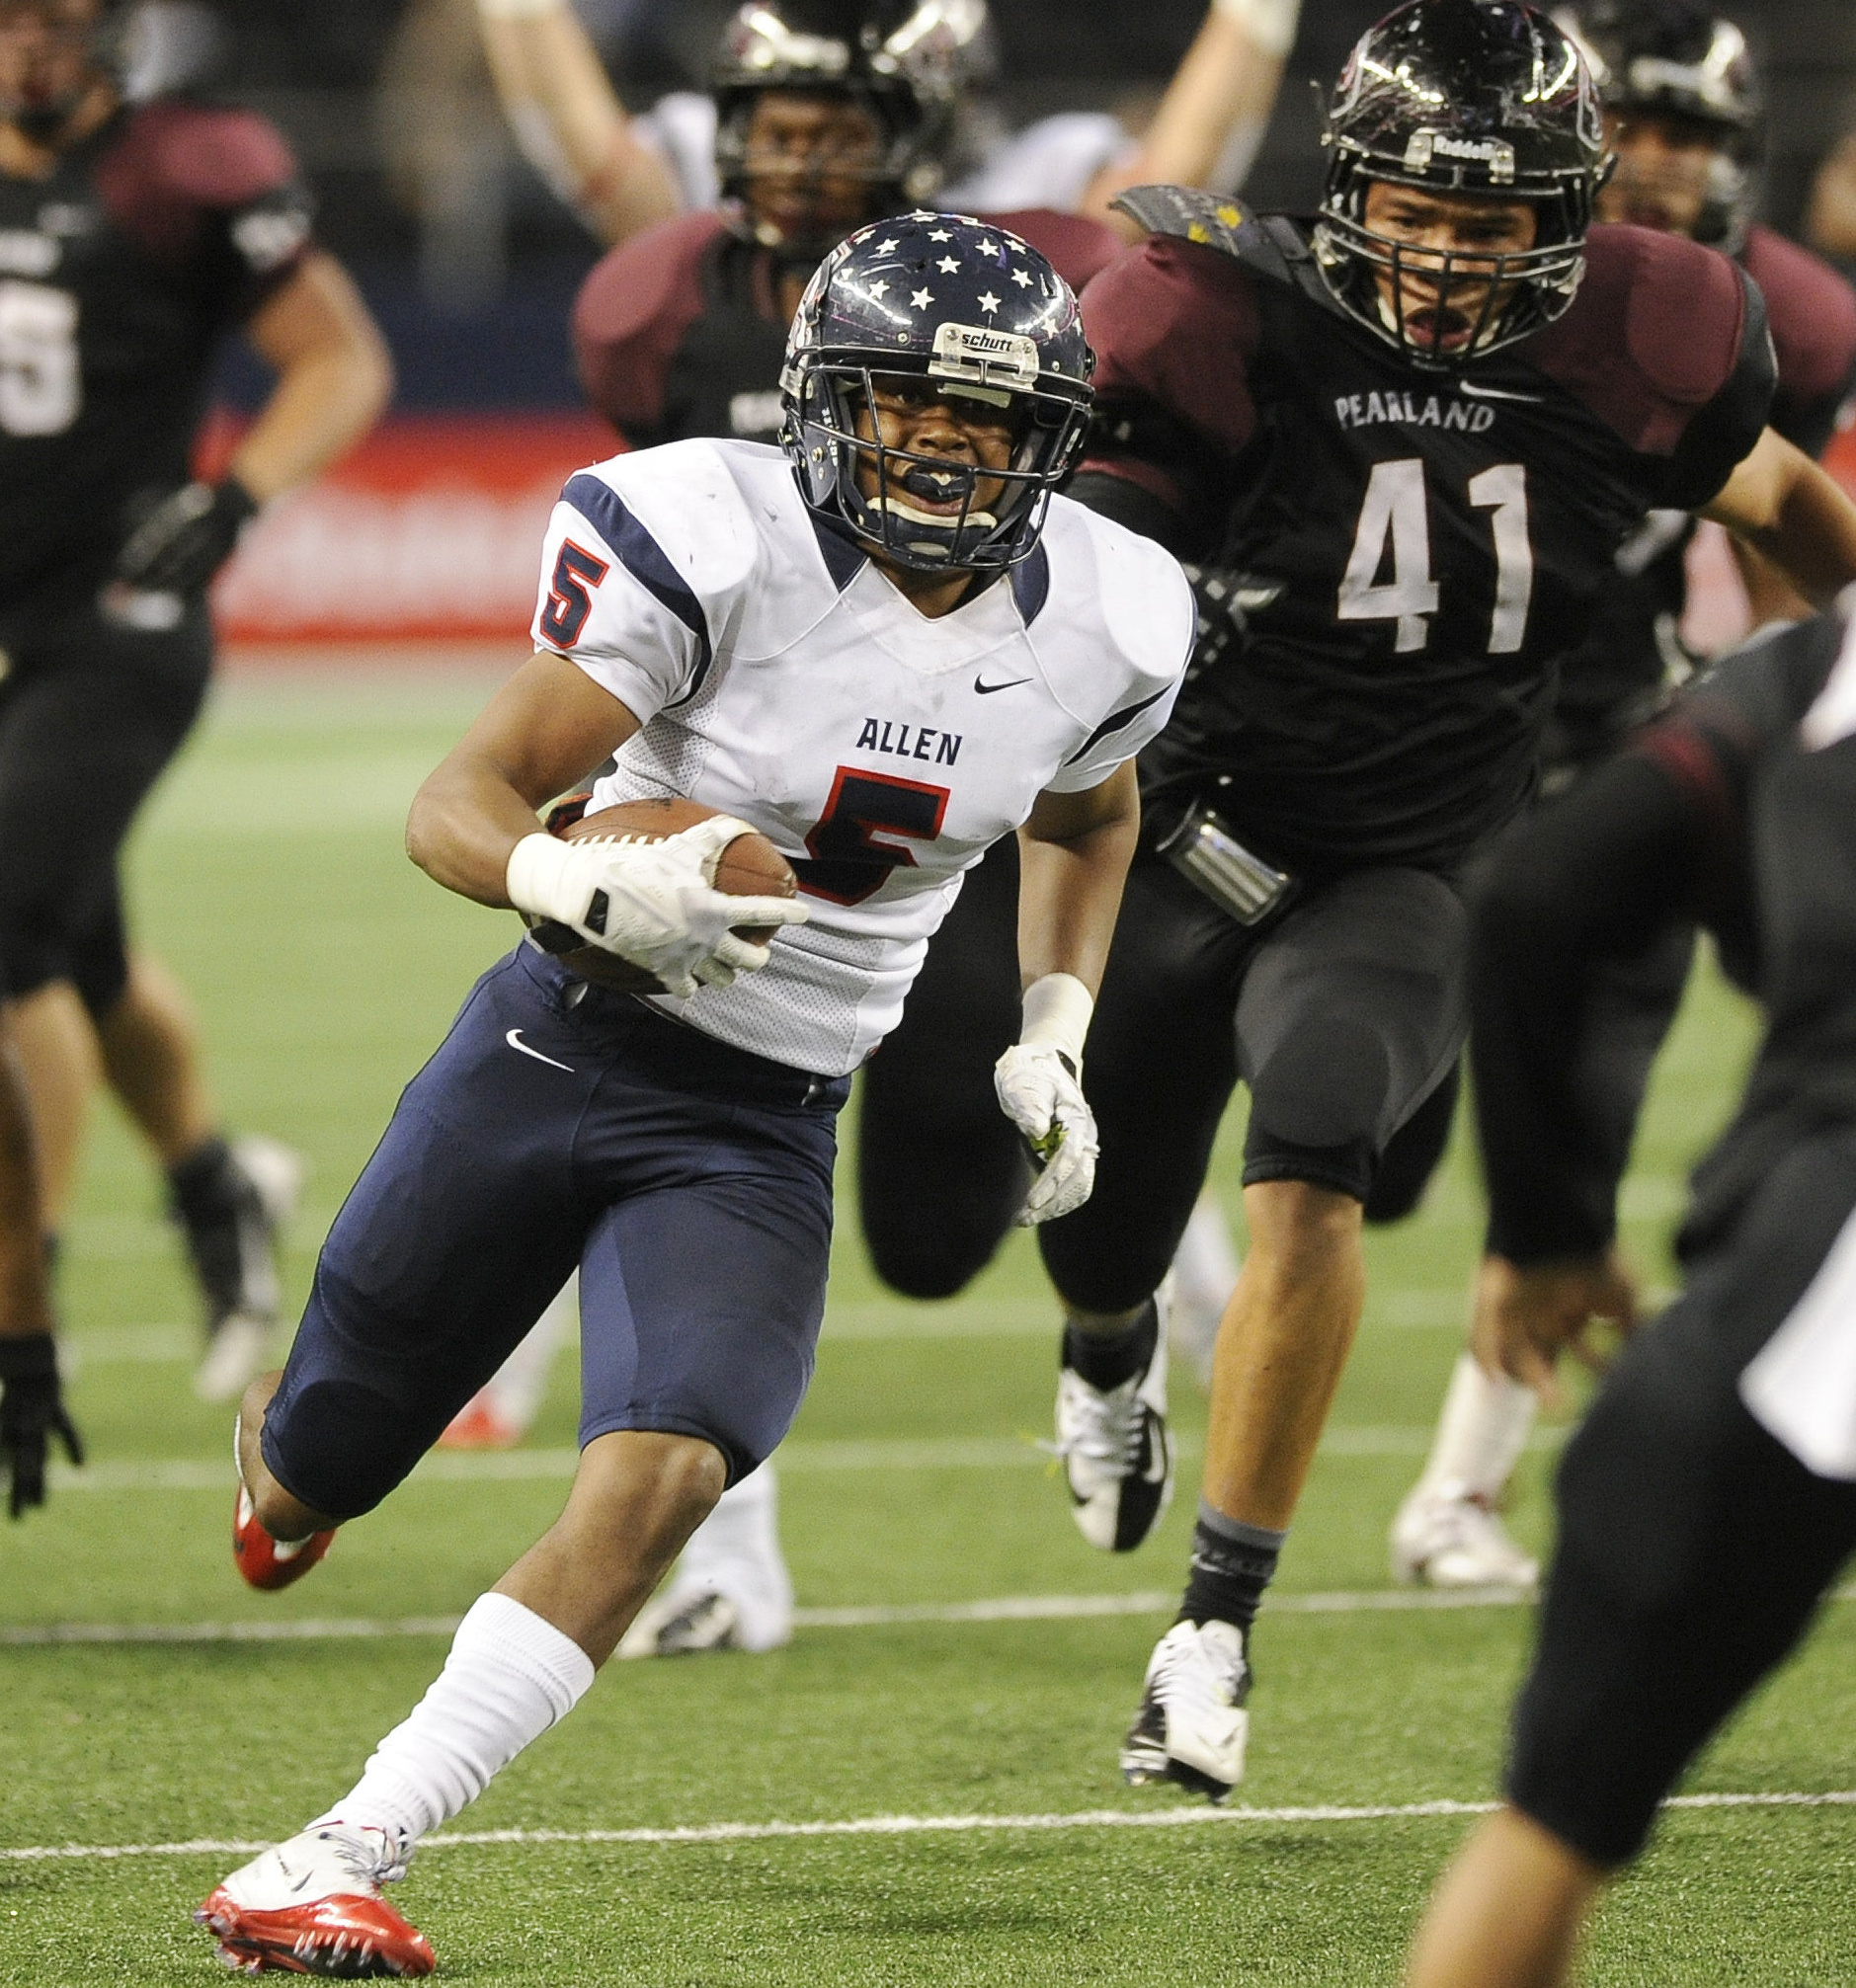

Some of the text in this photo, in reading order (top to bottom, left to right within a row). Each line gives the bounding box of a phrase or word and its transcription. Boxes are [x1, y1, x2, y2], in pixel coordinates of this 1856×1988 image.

[961, 333, 1012, 353] schutt
[1334, 391, 1495, 433] PEARLAND
[538, 536, 610, 650] 5
[1337, 458, 1533, 653] 41
[856, 717, 963, 766] ALLEN
[784, 764, 951, 908] 5
